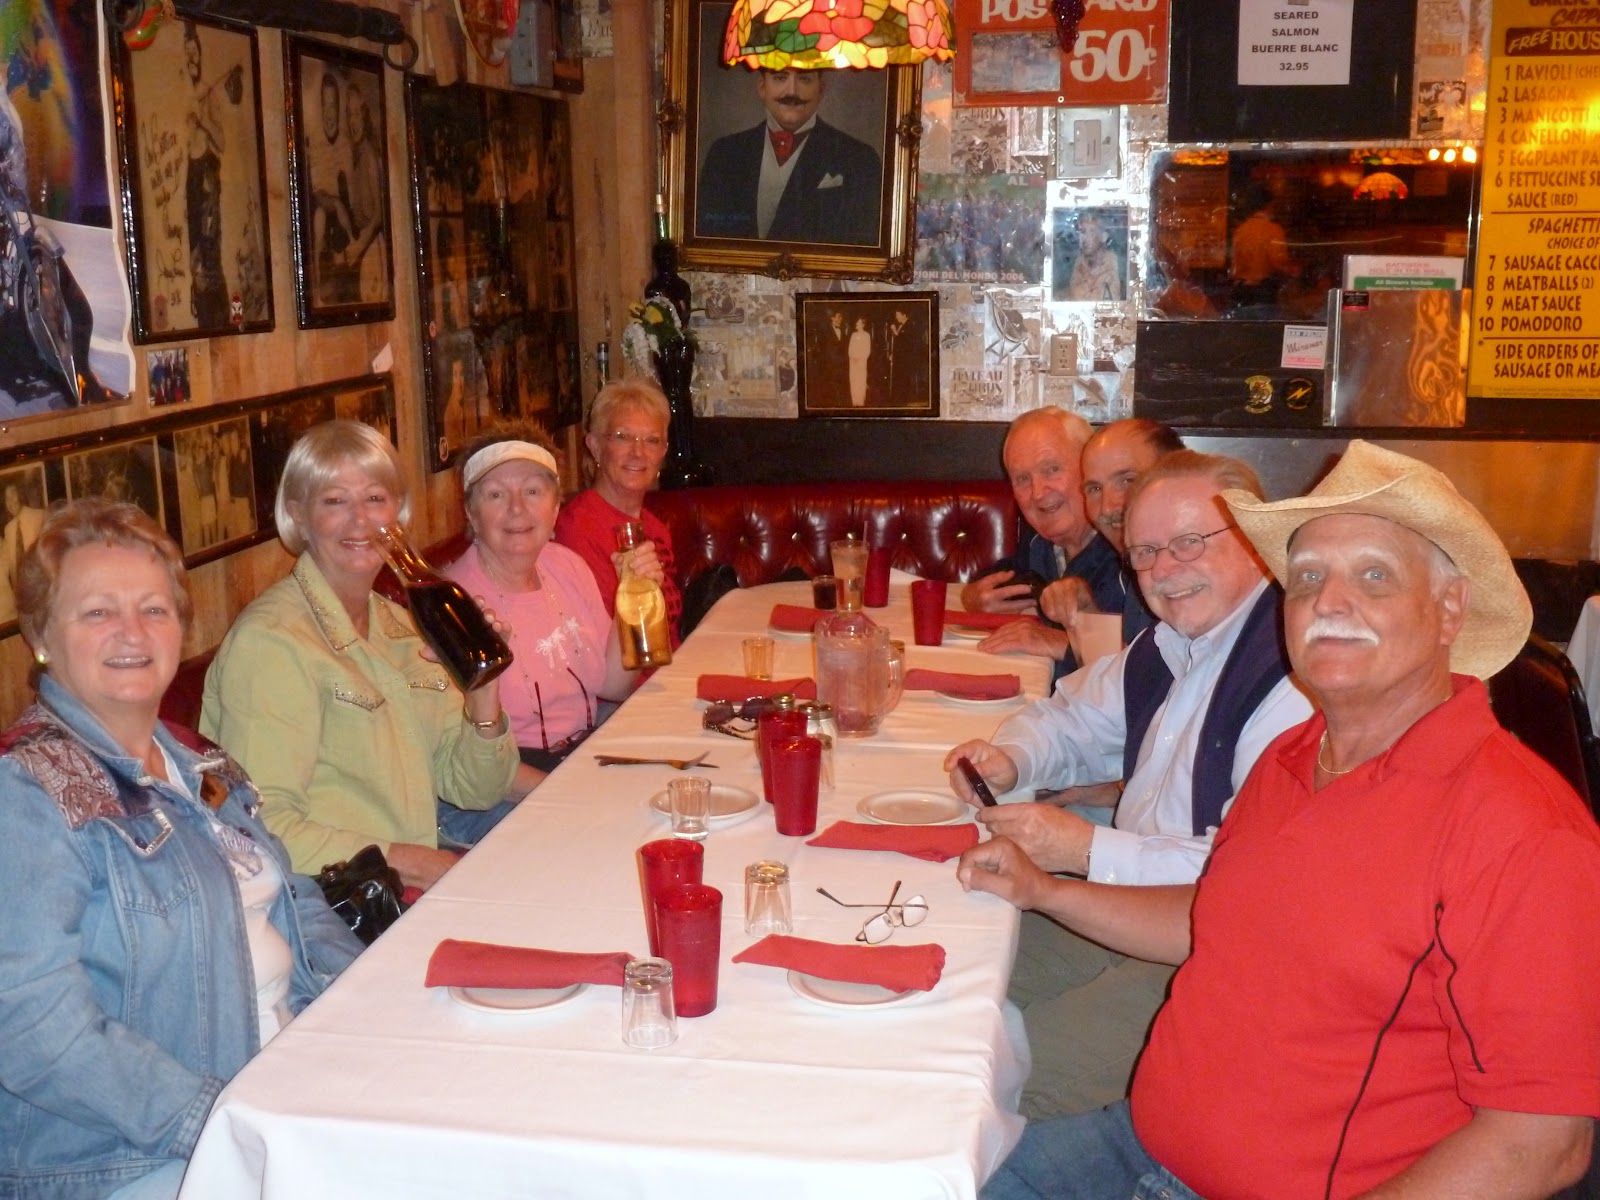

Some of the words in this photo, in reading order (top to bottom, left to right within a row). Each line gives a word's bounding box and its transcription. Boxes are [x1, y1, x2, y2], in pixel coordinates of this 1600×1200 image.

[1274, 11, 1319, 20] SEARED
[1271, 28, 1319, 37] SALMON
[1251, 44, 1297, 53] BUERRE
[1300, 44, 1339, 53] BLANC
[1508, 29, 1551, 54] FREE
[1279, 62, 1309, 71] 32.95
[1505, 65, 1511, 80] 1
[1515, 64, 1572, 80] RAVIOLI
[1502, 86, 1509, 102] 2
[1514, 86, 1577, 102] LASAGNA
[1500, 108, 1507, 124] 3
[1512, 108, 1590, 124] MANICOTTI
[1497, 129, 1505, 144] 4
[1511, 129, 1587, 145] CANELLONI
[1497, 150, 1505, 166] 5
[1510, 150, 1579, 166] EGGPLANT
[1495, 171, 1503, 187] 6
[1509, 171, 1586, 188] FETTUCCINE
[1508, 192, 1547, 208] SAUCE
[1550, 194, 1578, 207] (RED)
[1528, 217, 1600, 234] SPAGHETTI
[1547, 237, 1585, 249] CHOICE
[1587, 237, 1600, 249] OF
[1489, 256, 1496, 271] 7
[1504, 255, 1562, 271] SAUSAGE
[941, 271, 959, 280] DEL
[962, 271, 998, 281] MONDO
[1000, 272, 1024, 281] 2006
[1487, 276, 1495, 291] 8
[1503, 276, 1578, 291] MEATBALLS
[1486, 296, 1493, 311] 9
[1502, 296, 1537, 311] MEAT
[1541, 296, 1581, 311] SAUCE
[1479, 317, 1494, 332] 10
[1501, 316, 1582, 332] POMODORO
[1496, 344, 1523, 359] SIDE
[1527, 344, 1578, 360] ORDERS
[1582, 344, 1599, 359] OF
[1494, 362, 1551, 378] SAUSAGE
[1555, 363, 1573, 378] OR
